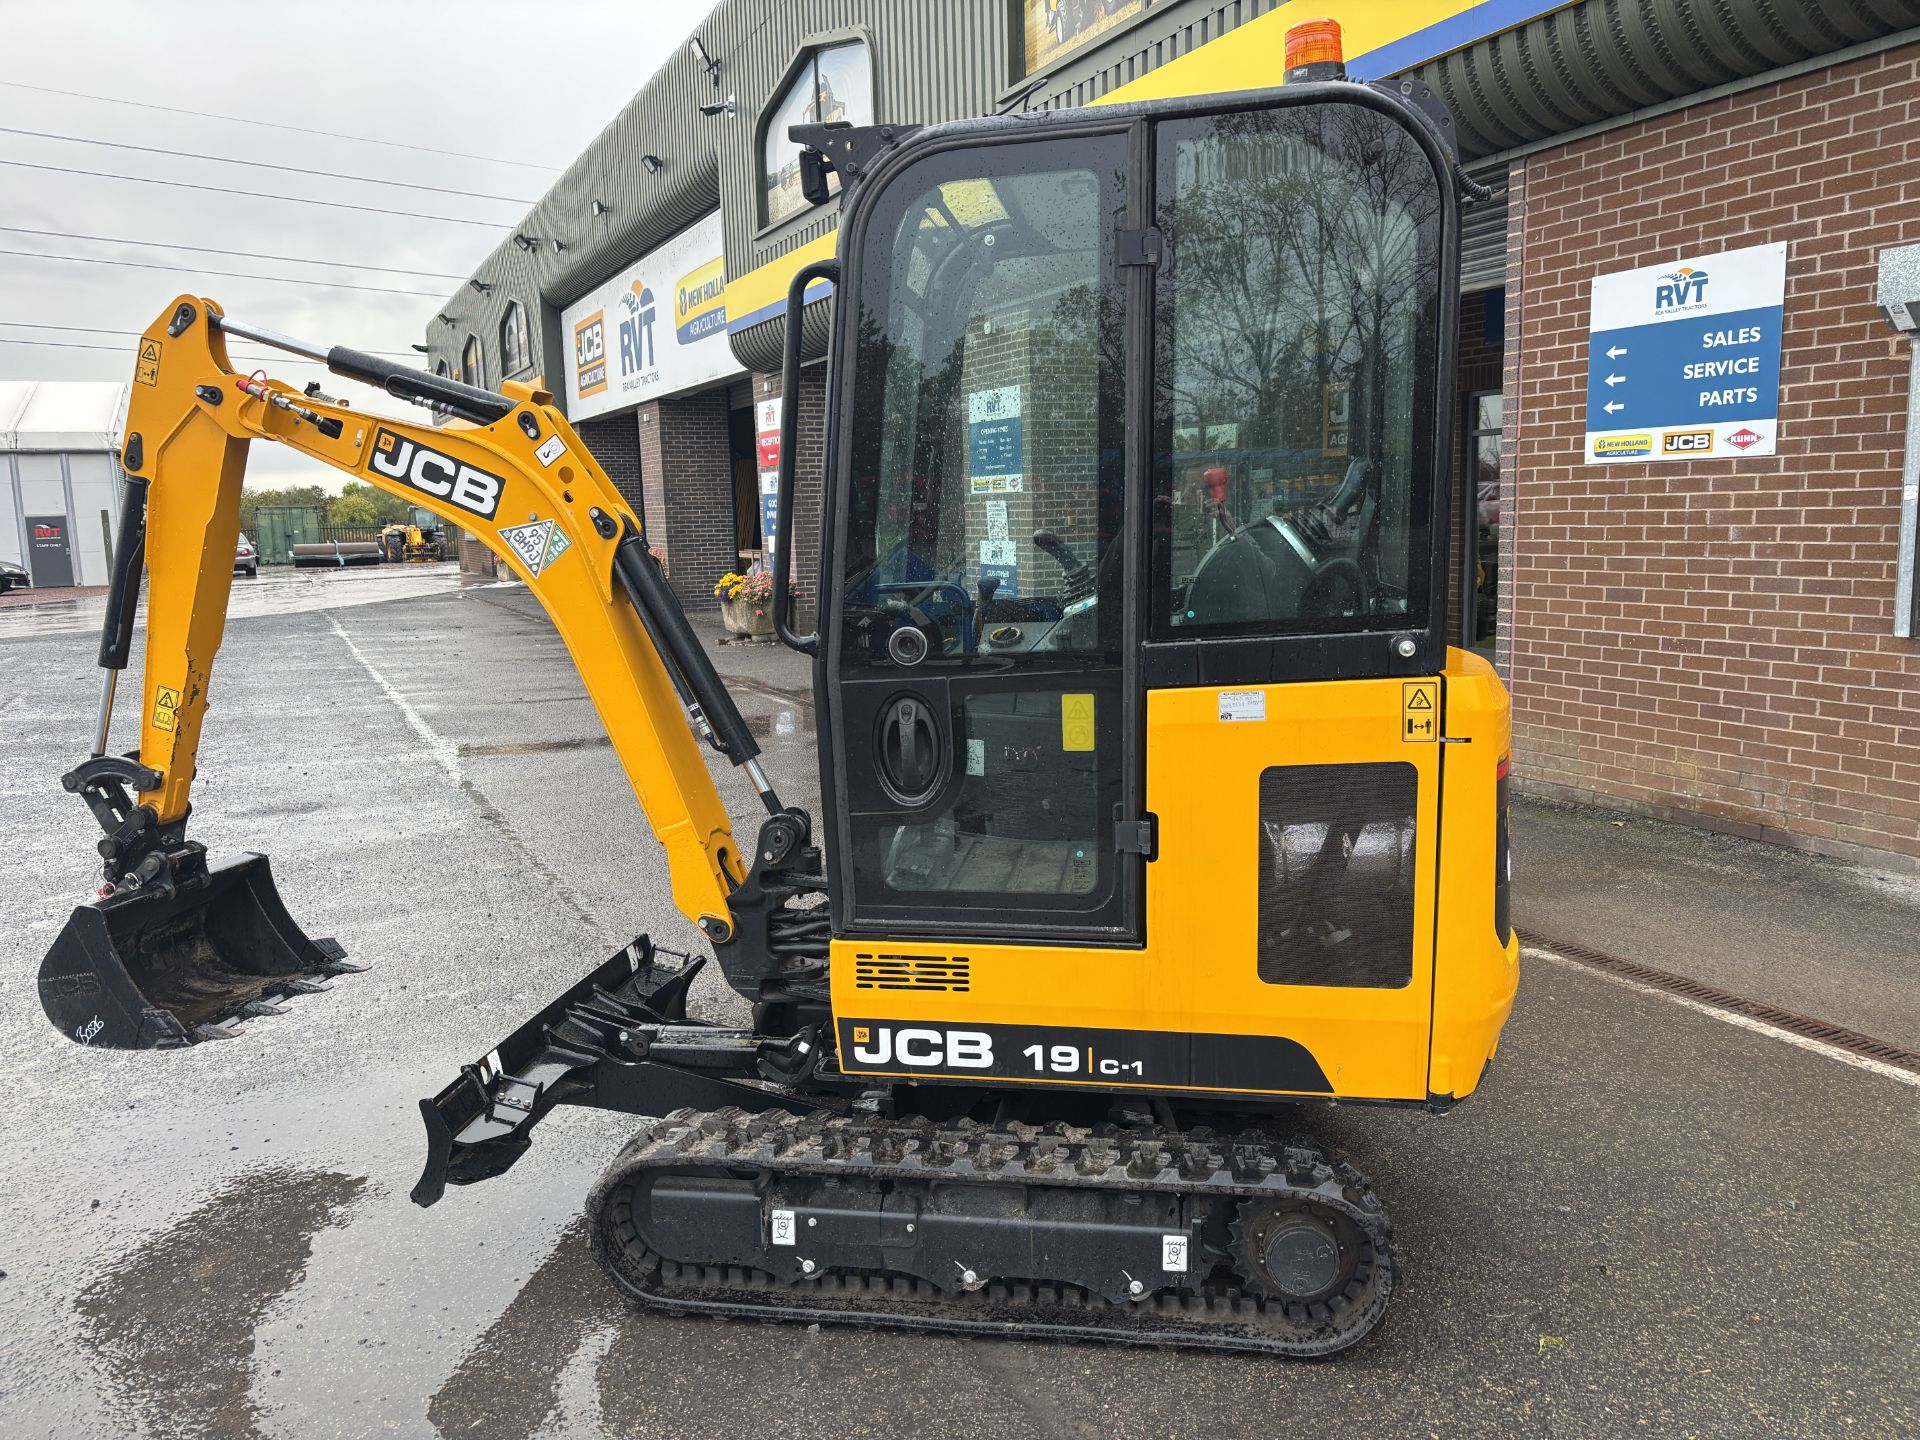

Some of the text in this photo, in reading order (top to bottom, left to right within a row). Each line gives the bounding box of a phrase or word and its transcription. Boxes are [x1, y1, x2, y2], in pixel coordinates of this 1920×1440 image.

[688, 286, 702, 309] NEW
[1656, 278, 1708, 309] RVT
[1682, 303, 1707, 311] TRACTORS
[689, 309, 725, 336] AGRICULTURE
[578, 323, 602, 364] JCB
[619, 306, 655, 377] RVT
[1703, 326, 1761, 348] SALES
[642, 371, 660, 386] TRACTORS
[1683, 356, 1760, 380] SERVICE
[986, 400, 1001, 413] RVT
[1699, 387, 1758, 407] PARTS
[1620, 439, 1648, 447] HOLLAND
[1665, 434, 1710, 451] JCB
[1730, 434, 1758, 443] KUHN
[373, 441, 499, 514] JCB
[35, 527, 60, 537] RVT
[528, 528, 545, 546] 95
[513, 530, 541, 561] BH9J
[853, 1027, 994, 1068] JCB
[1022, 1045, 1080, 1073] 19
